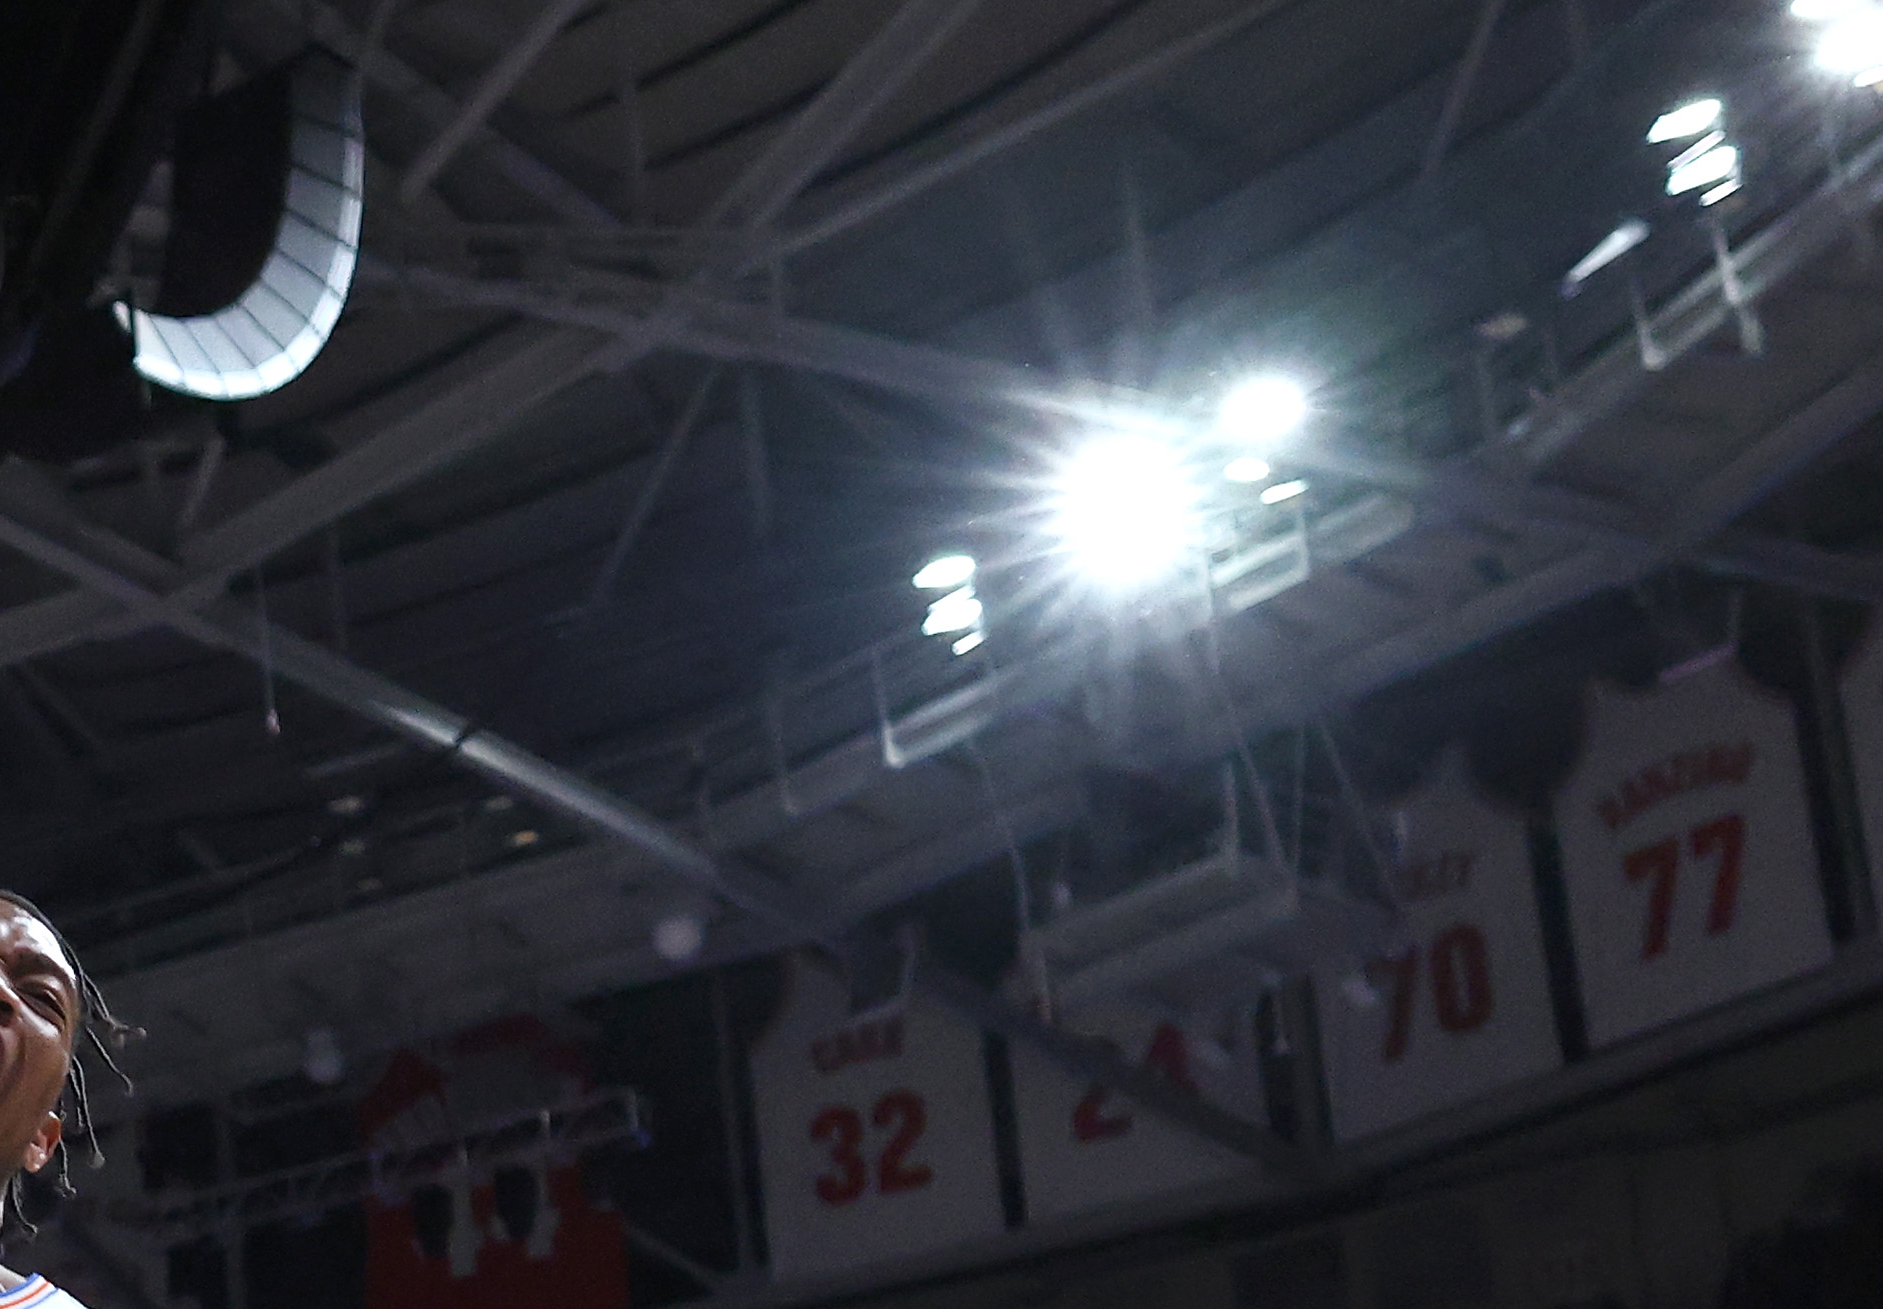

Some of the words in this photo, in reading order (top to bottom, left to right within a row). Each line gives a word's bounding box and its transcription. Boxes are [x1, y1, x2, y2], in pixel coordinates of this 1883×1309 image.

[1623, 814, 1747, 963] 77
[1365, 923, 1496, 1064] 70
[810, 1089, 933, 1207] 32
